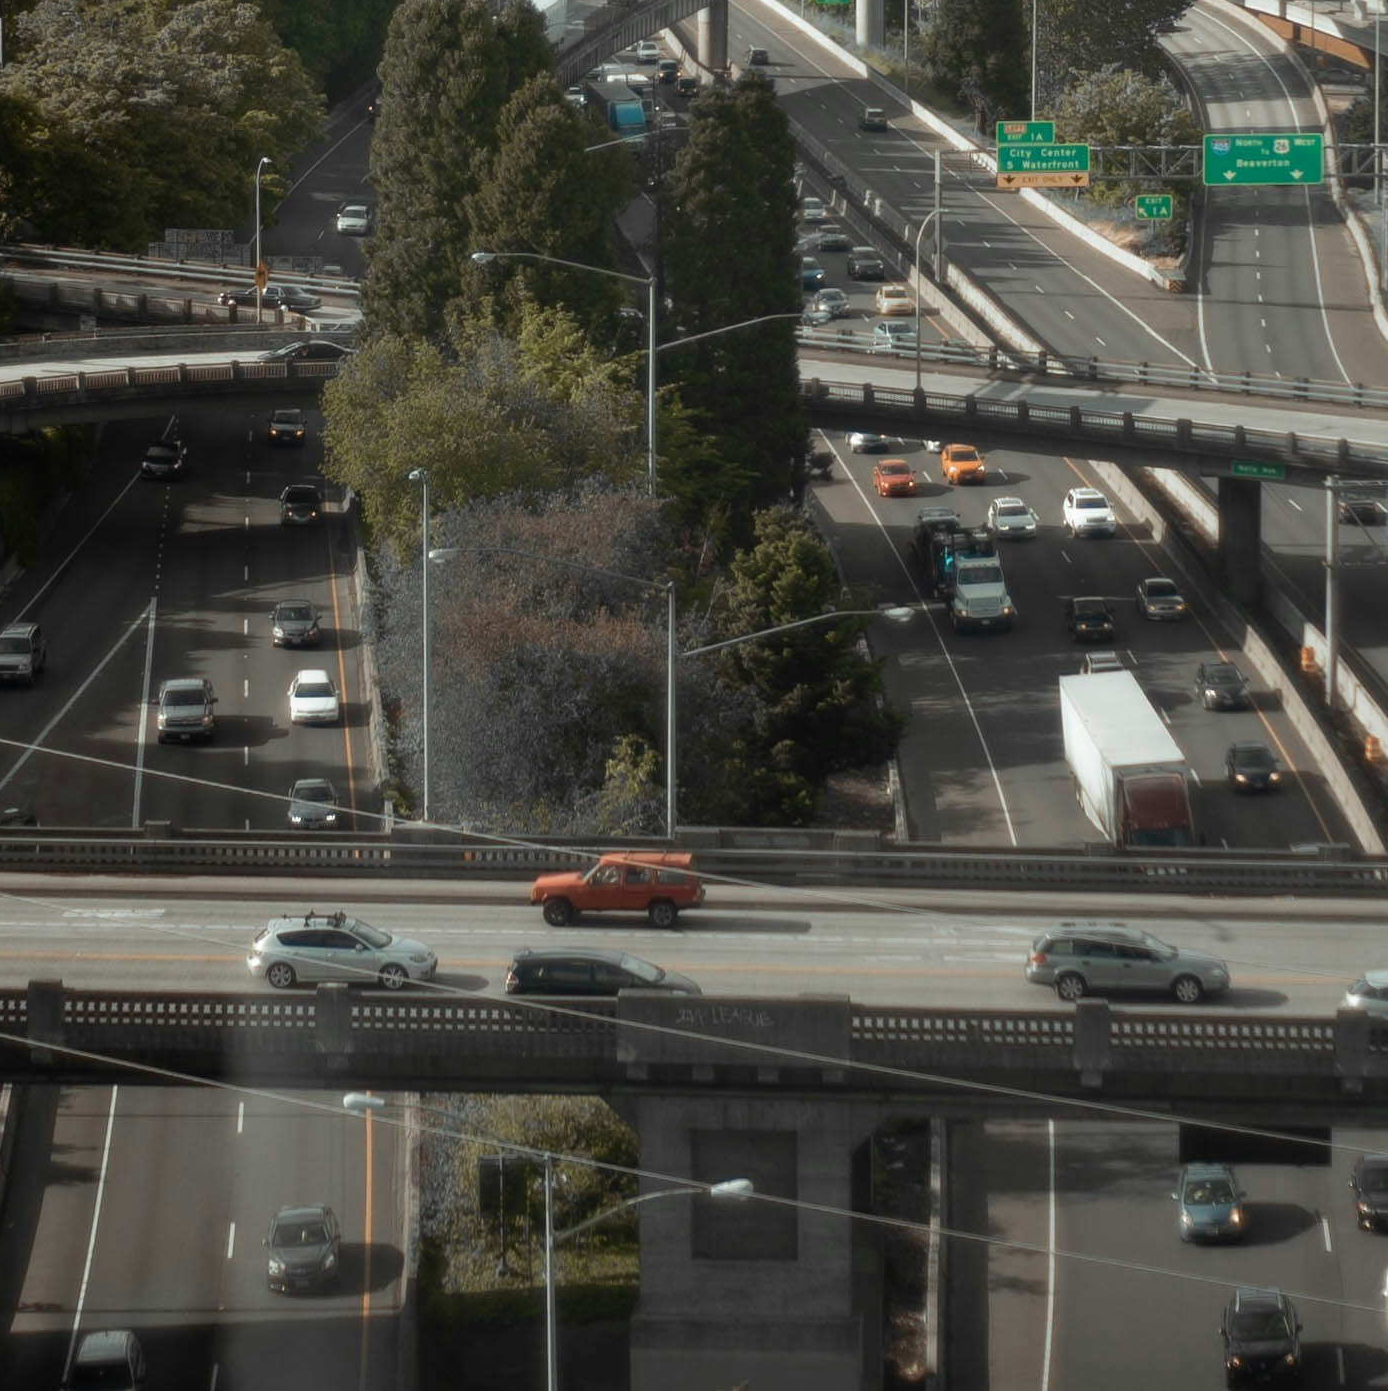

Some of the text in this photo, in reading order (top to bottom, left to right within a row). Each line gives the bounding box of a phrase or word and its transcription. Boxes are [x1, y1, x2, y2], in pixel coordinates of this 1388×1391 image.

[1009, 148, 1077, 159] City Center
[1022, 160, 1079, 169] Waterfront
[1236, 159, 1291, 168] Beaverton
